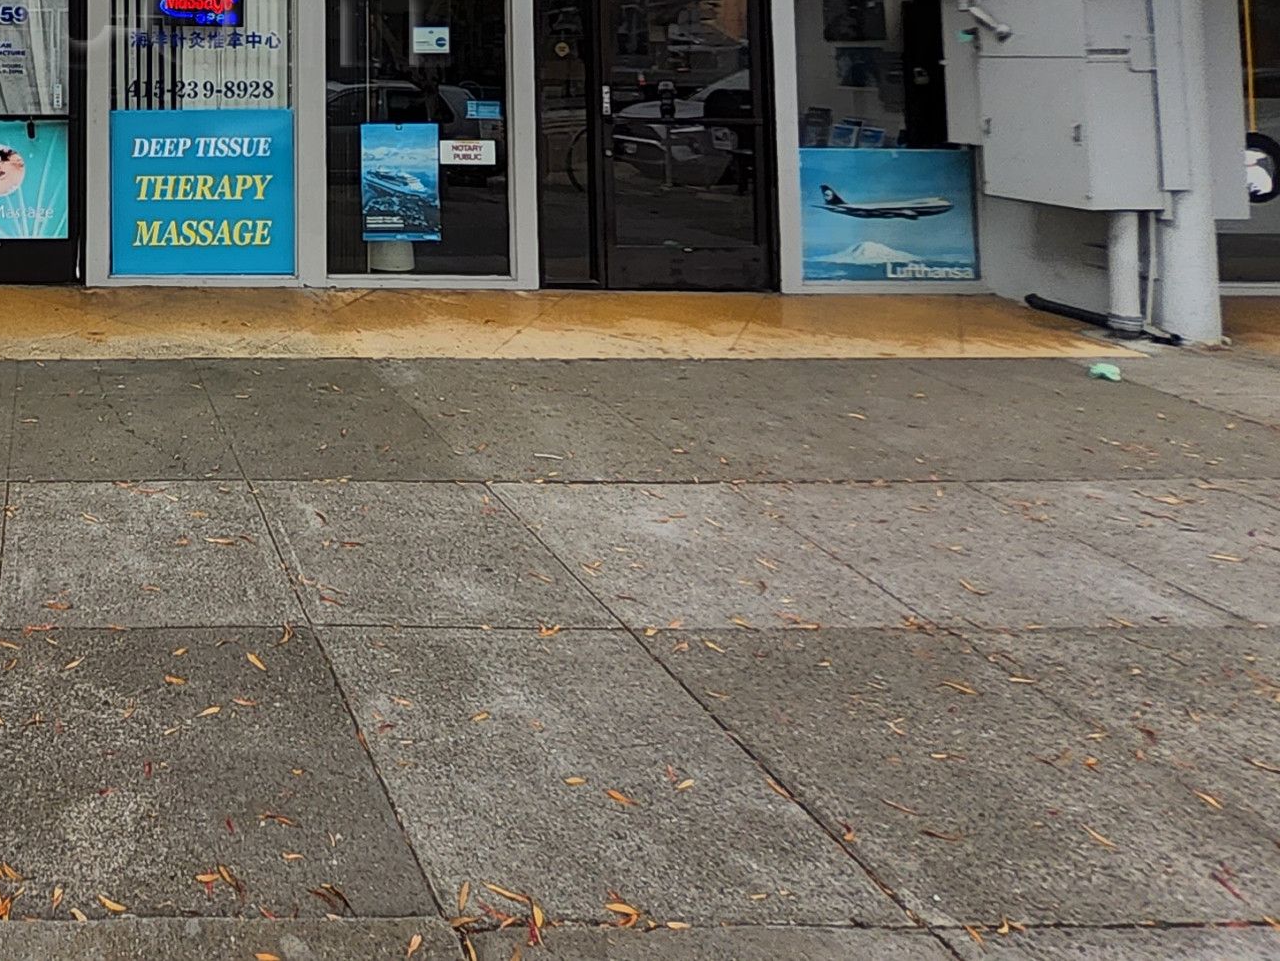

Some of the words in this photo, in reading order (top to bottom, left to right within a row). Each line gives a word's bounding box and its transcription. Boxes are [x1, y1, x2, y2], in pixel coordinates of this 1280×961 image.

[132, 137, 192, 158] DEEP
[195, 137, 272, 158] TISSUE
[451, 144, 483, 152] NOTARY
[453, 153, 483, 161] PUBLIC
[135, 174, 273, 201] THERAPY
[132, 219, 272, 246] MASSAGE
[886, 262, 974, 279] Lufthansa
